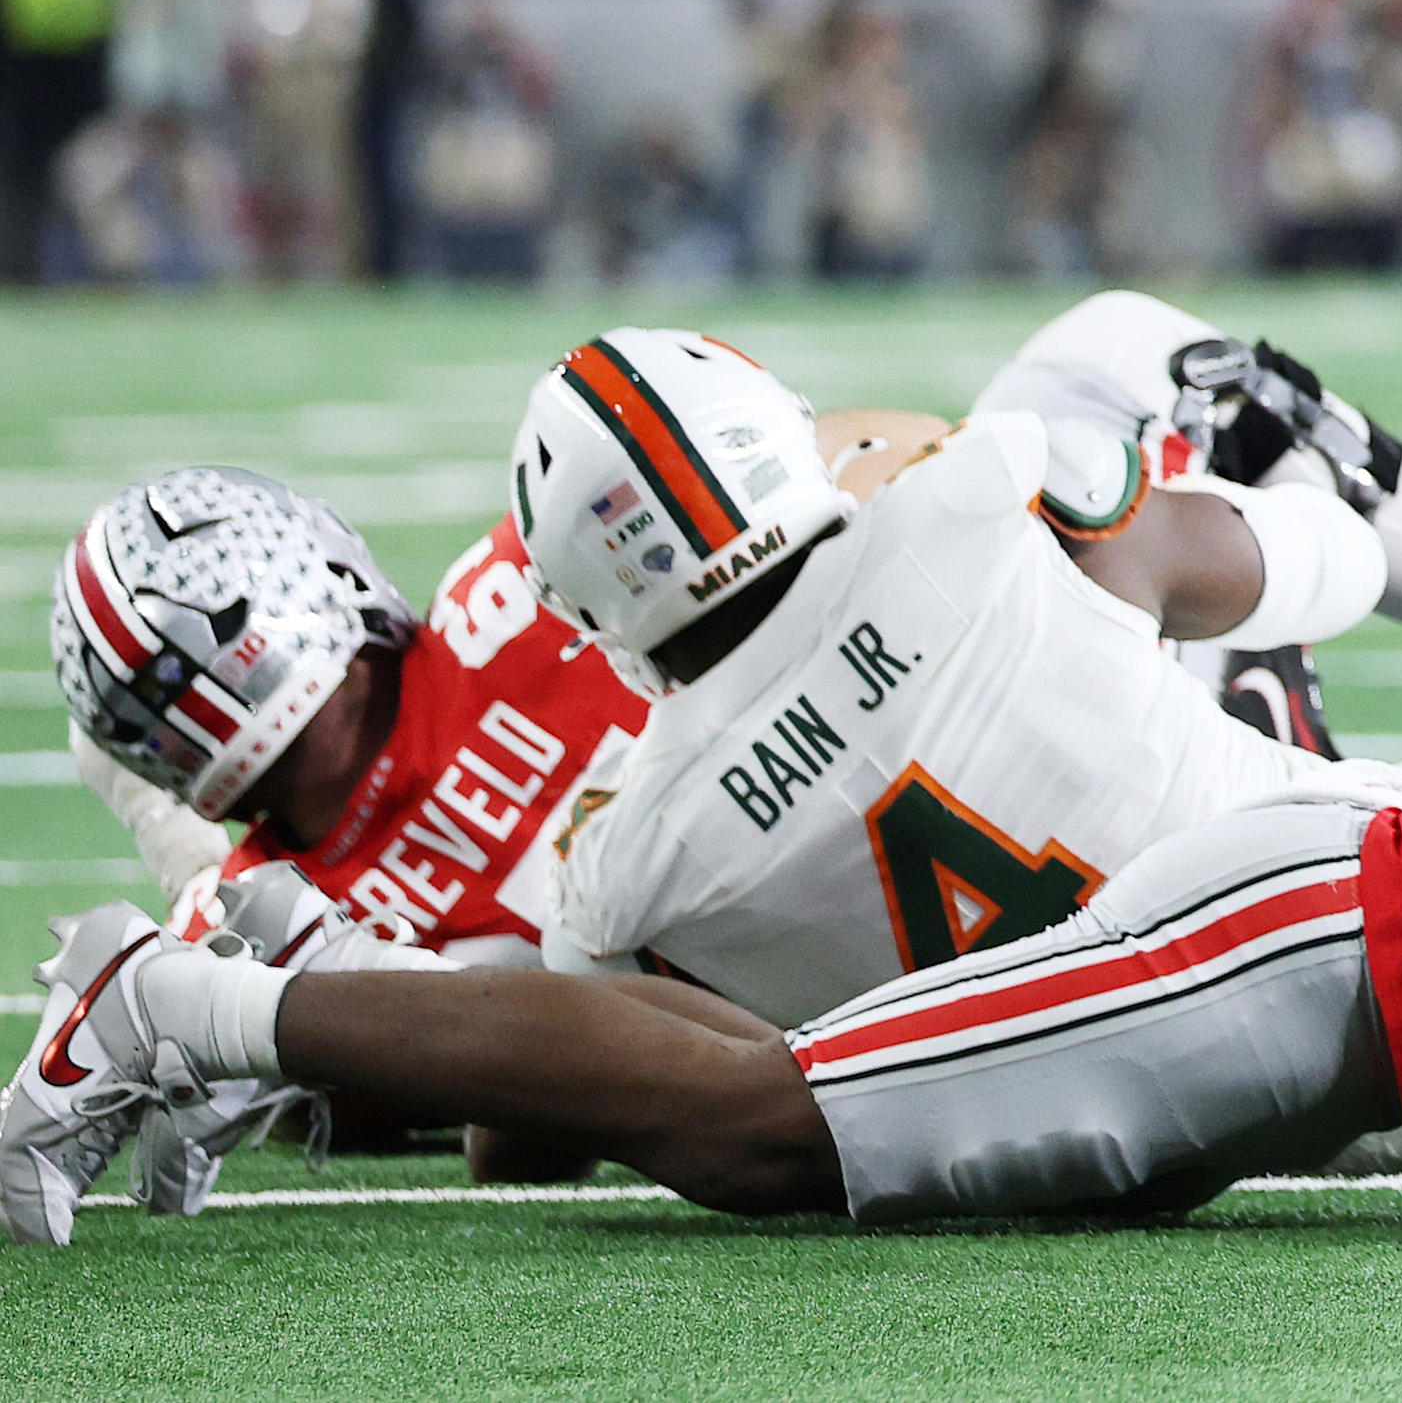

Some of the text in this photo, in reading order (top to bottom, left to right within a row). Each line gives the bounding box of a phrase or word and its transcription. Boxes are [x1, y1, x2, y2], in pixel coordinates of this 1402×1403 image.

[686, 524, 788, 603] MIAMI
[341, 699, 567, 932] REVELD
[719, 620, 924, 833] BAIN JR.
[864, 759, 1109, 975] 4
